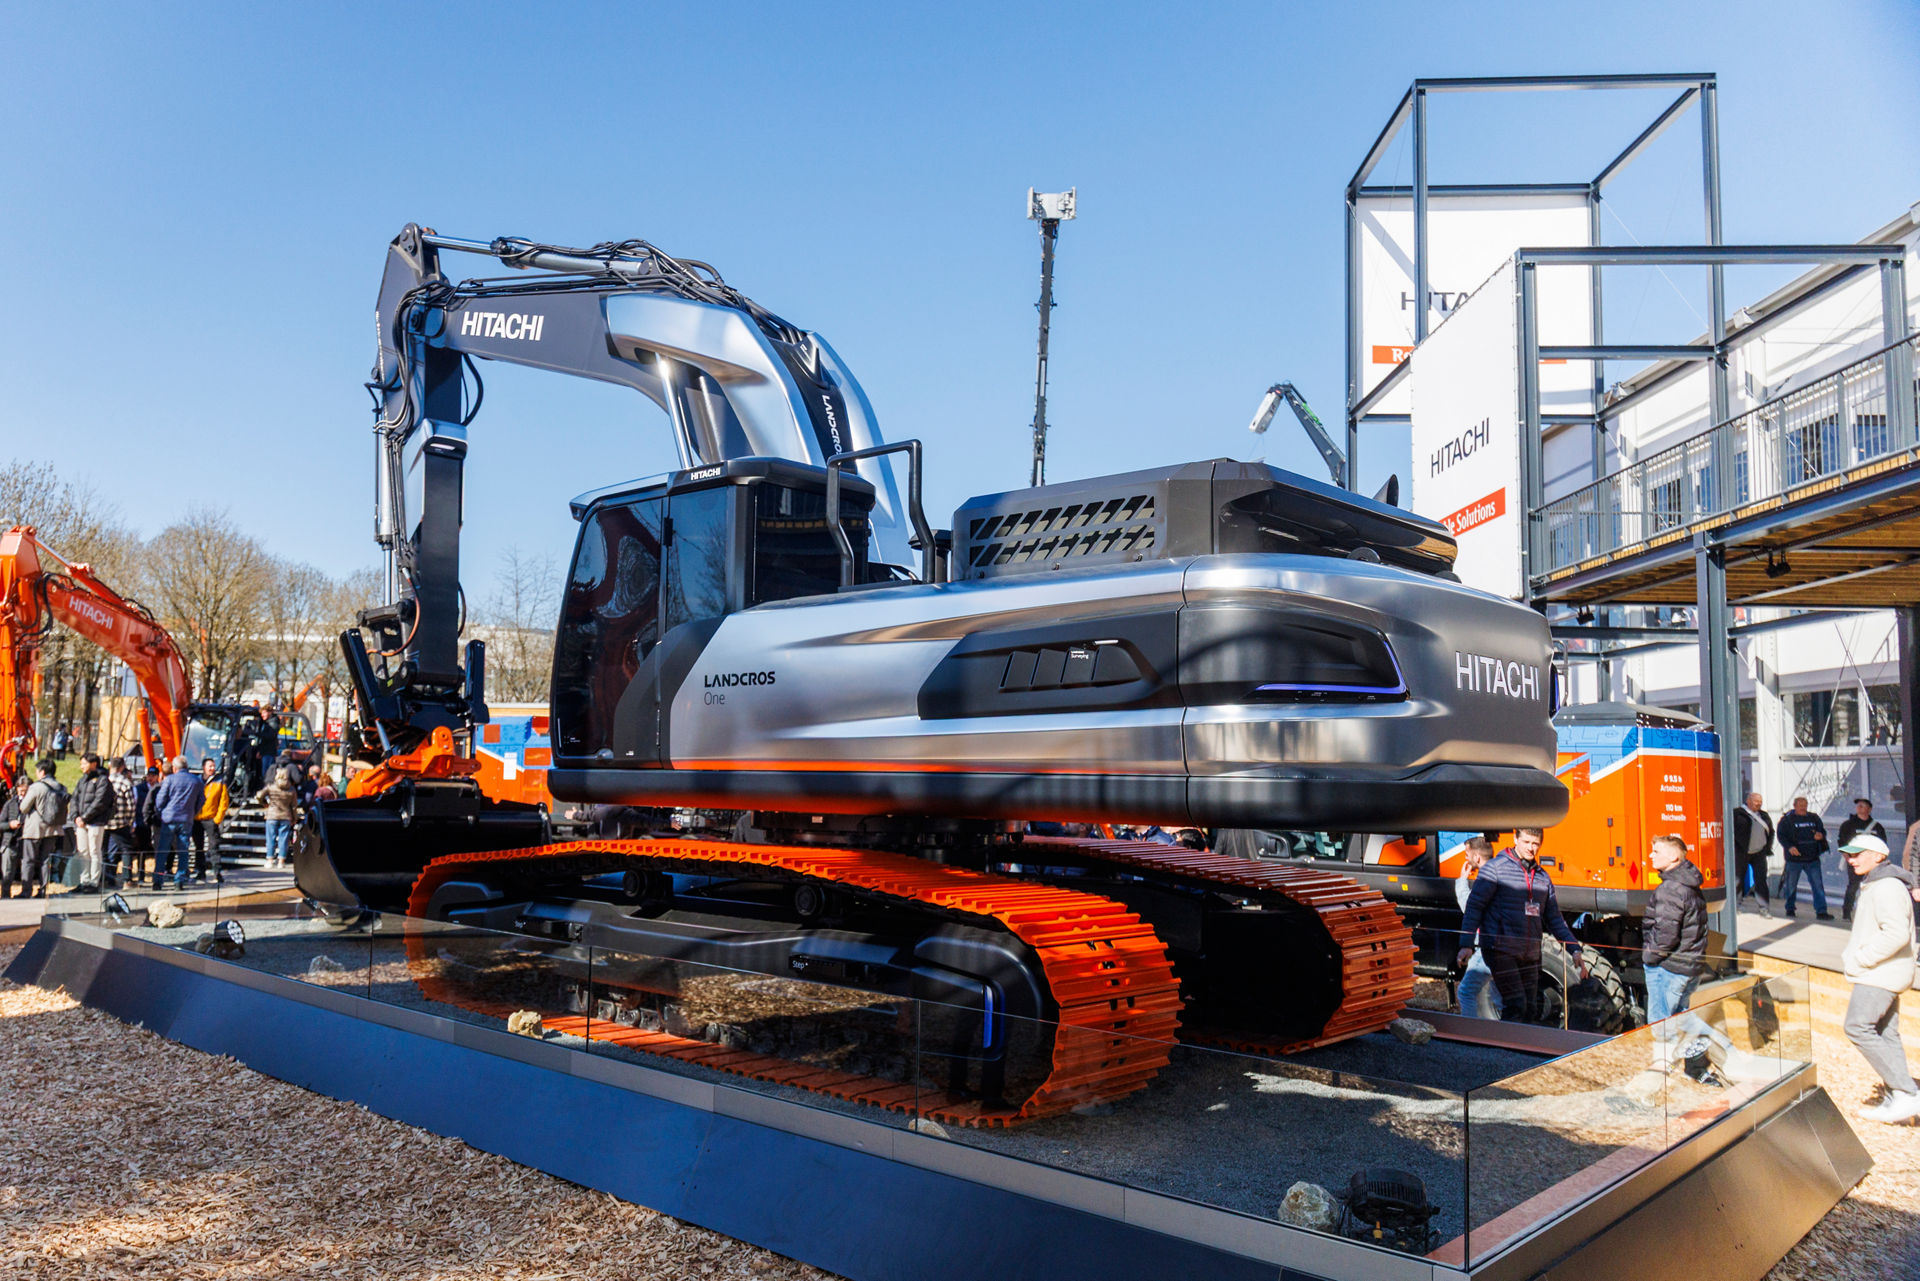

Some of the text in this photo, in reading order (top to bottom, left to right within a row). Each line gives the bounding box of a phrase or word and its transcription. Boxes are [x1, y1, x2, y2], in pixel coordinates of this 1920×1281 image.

[461, 311, 544, 341] HITACHI
[822, 394, 843, 456] LANDCRO
[1431, 417, 1489, 478] HITACHI
[690, 467, 721, 481] HITACHI
[1456, 501, 1496, 532] Solutions
[69, 596, 113, 629] HITACHI
[704, 671, 776, 688] LANDCROS
[1455, 651, 1540, 701] HITACHI
[704, 691, 726, 706] One
